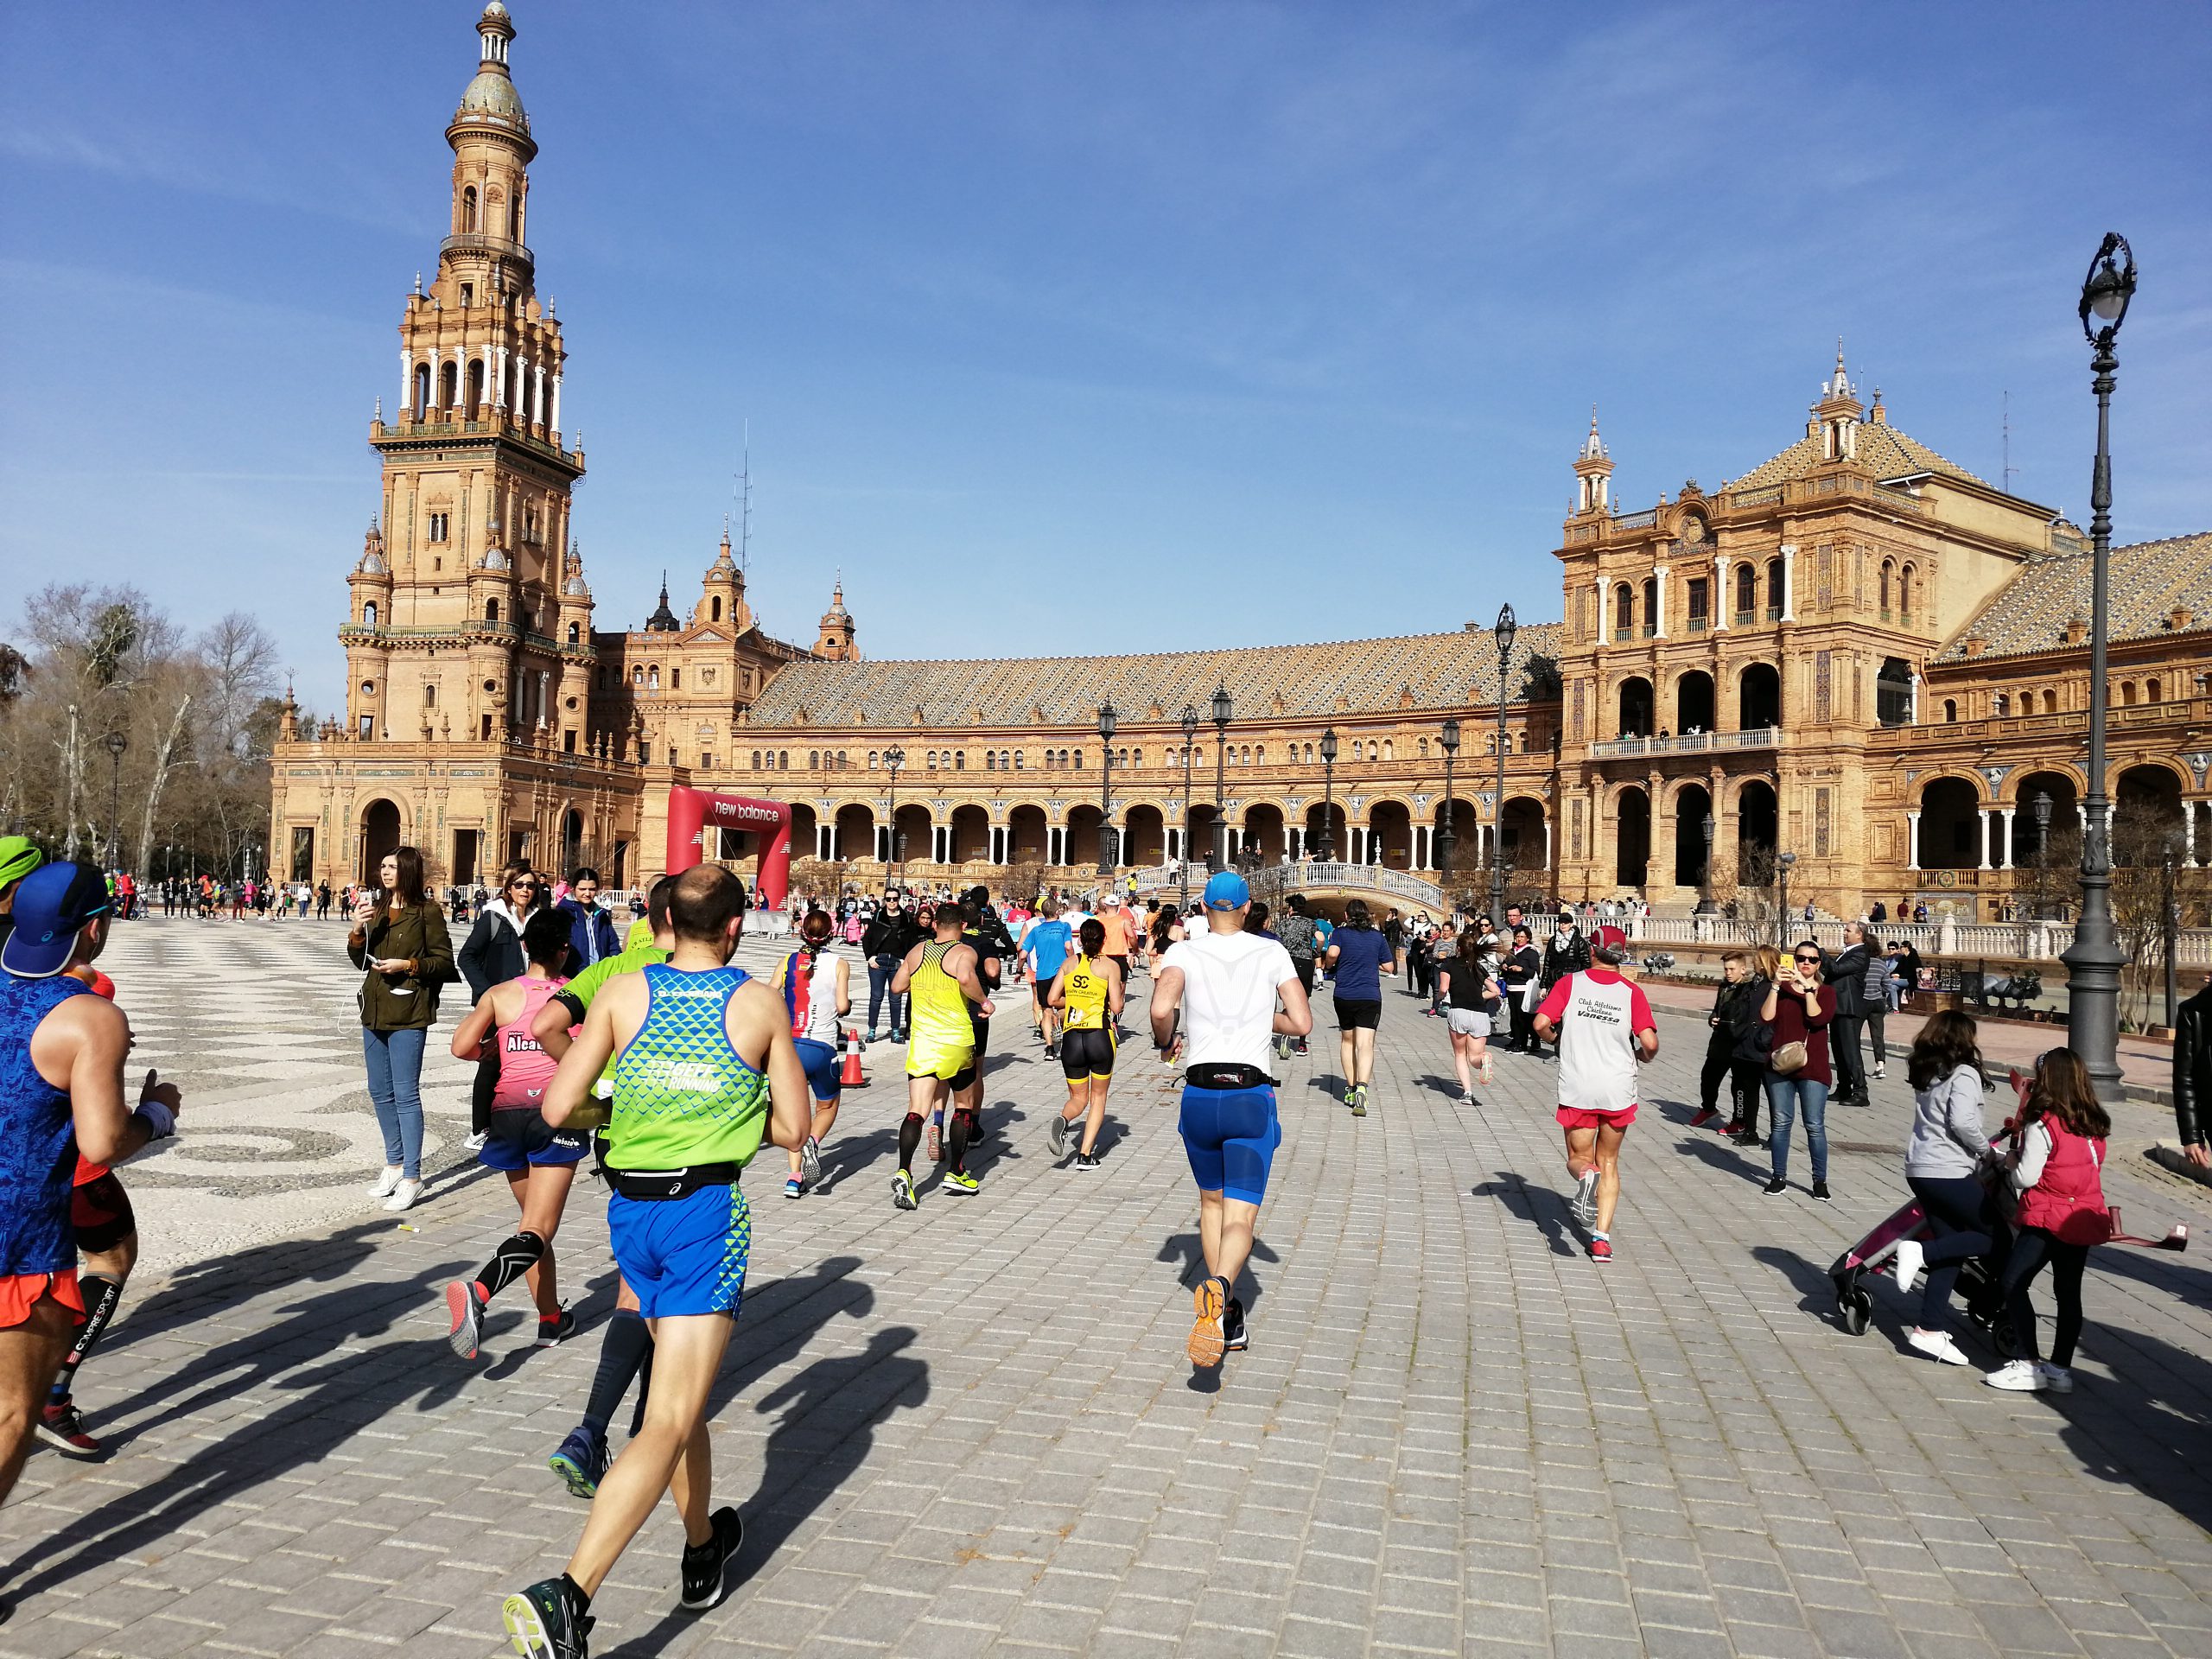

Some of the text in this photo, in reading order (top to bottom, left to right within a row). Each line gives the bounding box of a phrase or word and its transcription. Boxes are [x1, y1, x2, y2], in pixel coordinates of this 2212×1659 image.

[715, 801, 779, 823] new balance
[1578, 997, 1592, 1006] Club
[1577, 1010, 1620, 1023] Vanessa
[668, 1076, 722, 1094] RUNNING
